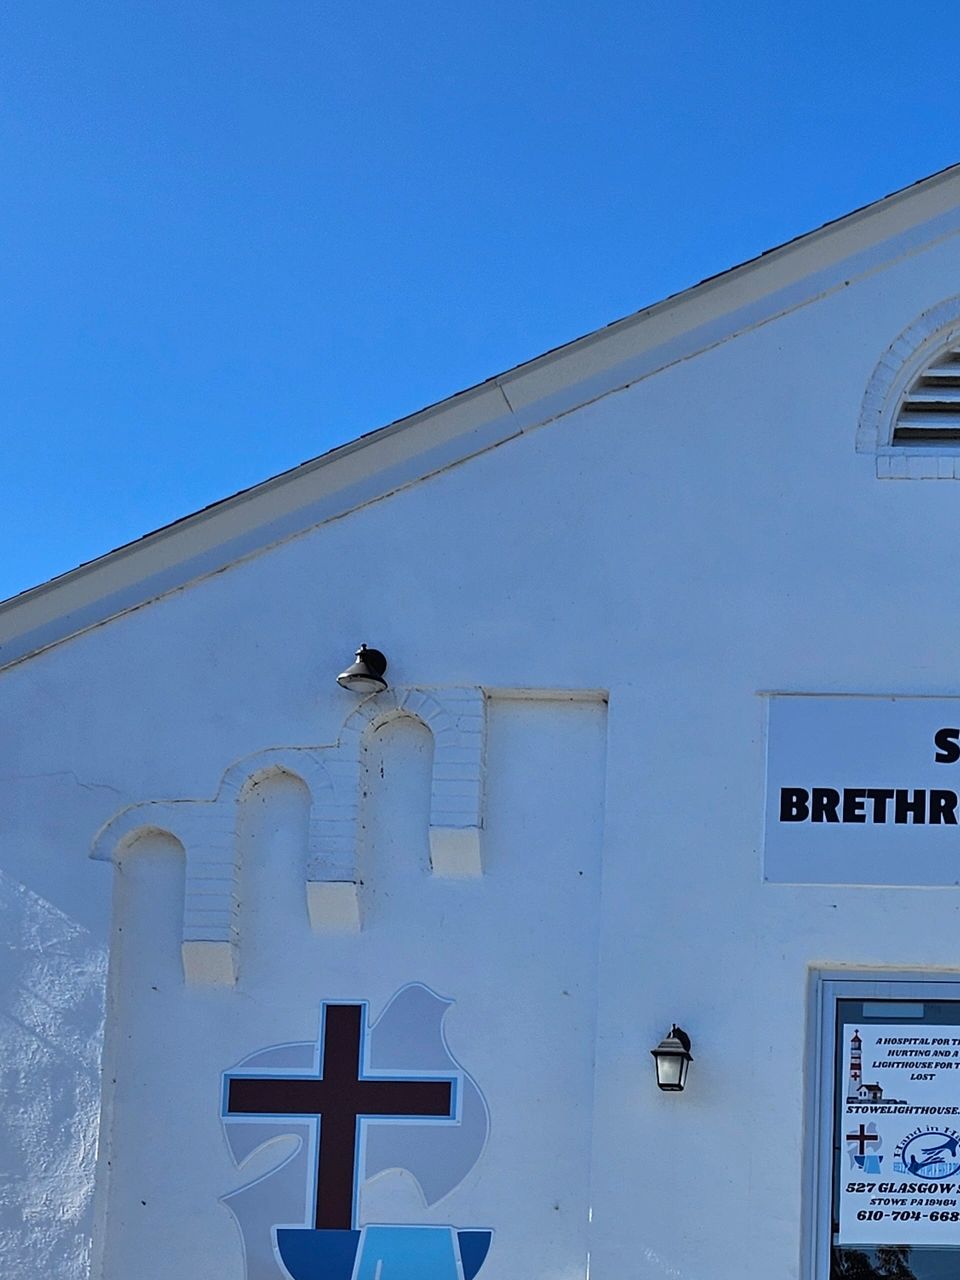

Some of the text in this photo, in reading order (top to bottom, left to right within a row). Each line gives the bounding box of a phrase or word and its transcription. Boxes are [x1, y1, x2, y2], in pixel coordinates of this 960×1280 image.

[875, 1037, 883, 1045] A
[883, 1037, 931, 1046] HOSPITAL
[931, 1038, 950, 1046] FOR
[887, 1049, 959, 1058] HURTING AND A
[871, 1061, 934, 1069] LIGHTHOUSE
[934, 1061, 954, 1070] FOR
[910, 1073, 937, 1081] LOST
[893, 1127, 922, 1157] Hand
[845, 1182, 877, 1194] 527
[877, 1182, 956, 1195] GLASGOW
[869, 1198, 908, 1206] STOWE
[909, 1198, 924, 1206] PA
